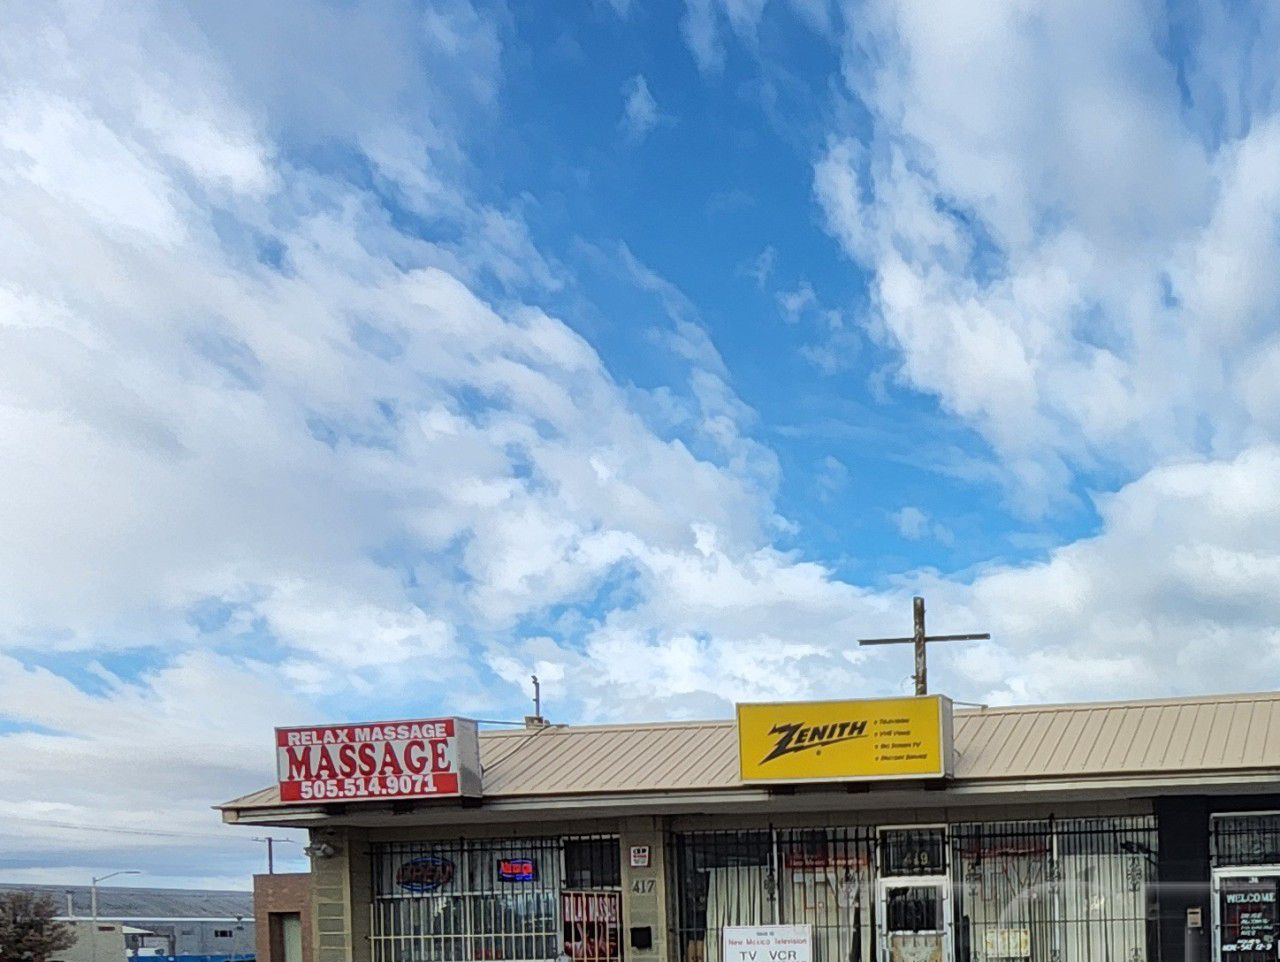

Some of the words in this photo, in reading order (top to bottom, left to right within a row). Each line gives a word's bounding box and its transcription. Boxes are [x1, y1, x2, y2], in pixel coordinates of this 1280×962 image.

[288, 728, 349, 746] RELAX
[355, 723, 447, 743] MASSAGE
[759, 720, 868, 765] ZENITH
[286, 738, 452, 781] MASSAGE
[300, 775, 437, 799] 505.514.9071
[632, 879, 656, 894] 417
[1226, 892, 1276, 904] WELCOME
[746, 938, 771, 946] Mexico
[774, 937, 807, 945] Television
[739, 951, 757, 961] TV
[769, 950, 797, 961] VCR
